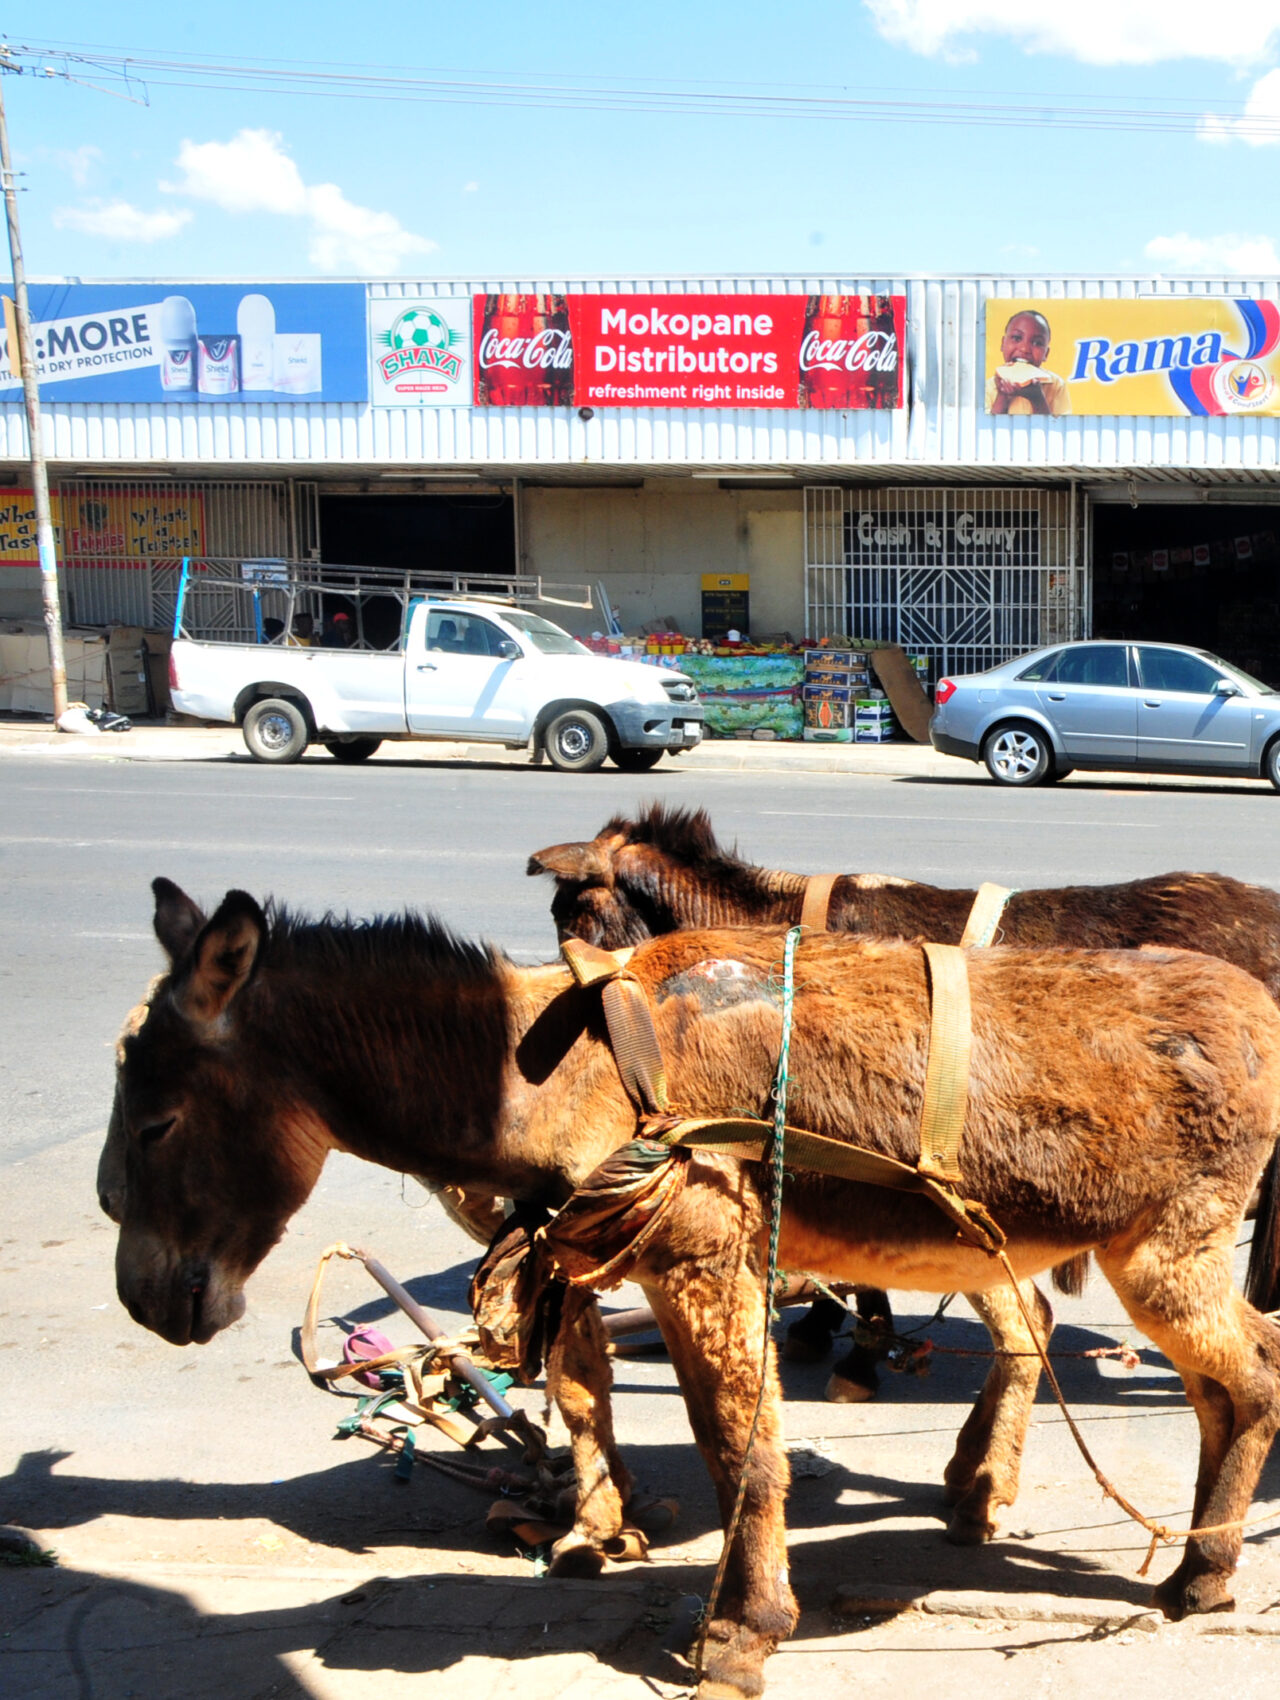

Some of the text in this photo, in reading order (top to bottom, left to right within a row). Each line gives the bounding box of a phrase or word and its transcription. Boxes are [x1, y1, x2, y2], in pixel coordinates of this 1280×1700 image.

[600, 308, 773, 341] Mokopane
[50, 359, 73, 373] DRY
[77, 346, 153, 368] PROTECTION
[479, 328, 574, 370] Coca-Cola
[594, 345, 778, 374] Distributors
[798, 330, 898, 372] Coca-Cola
[1070, 330, 1223, 381] Rama
[206, 364, 230, 374] Shield
[384, 350, 458, 376] SHAYA
[588, 384, 785, 403] refreshment right inside
[0, 505, 37, 525] Wha
[17, 525, 29, 535] a
[156, 527, 168, 537] a
[857, 513, 1016, 551] Cash & Carry
